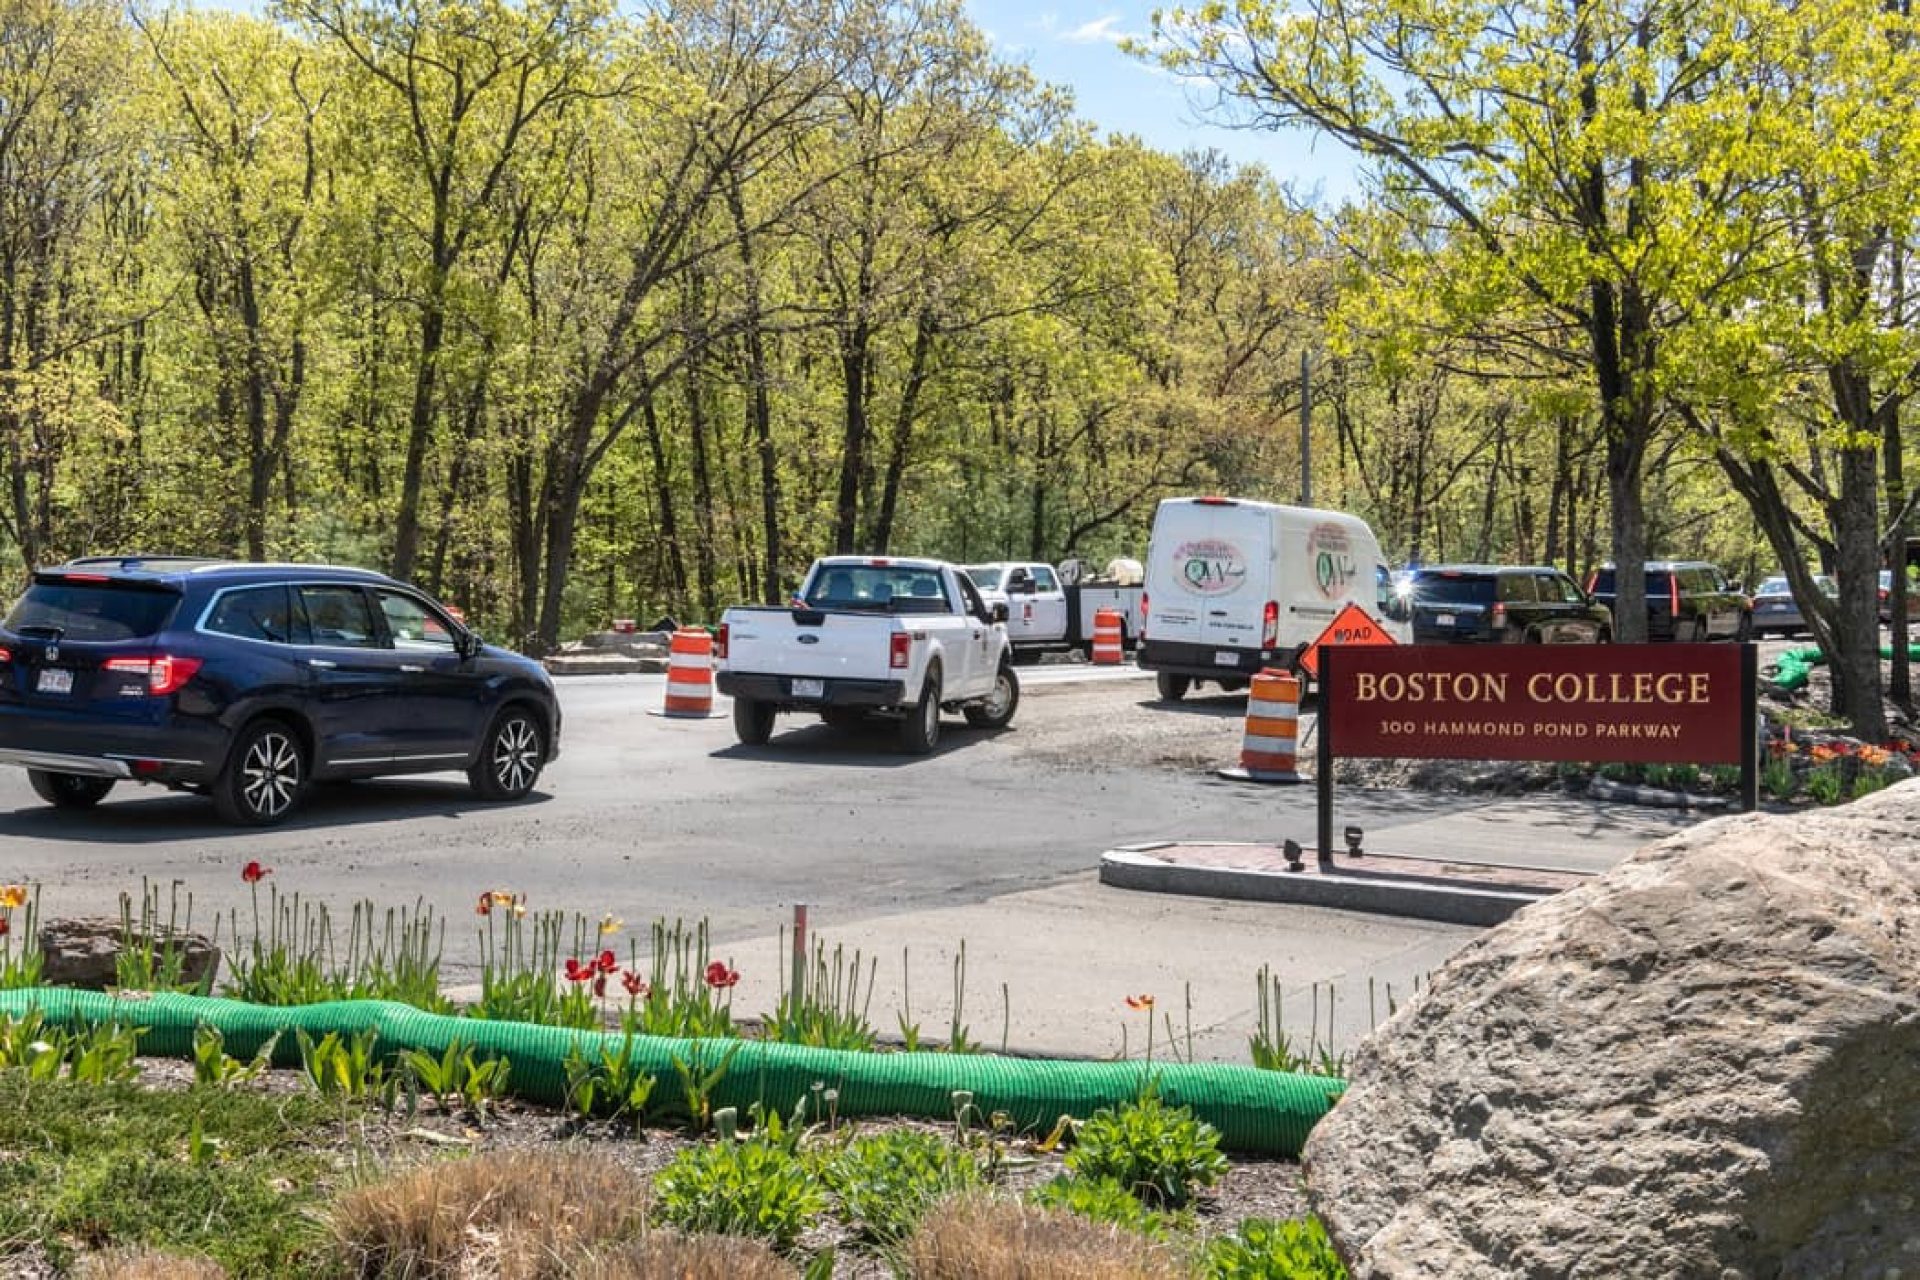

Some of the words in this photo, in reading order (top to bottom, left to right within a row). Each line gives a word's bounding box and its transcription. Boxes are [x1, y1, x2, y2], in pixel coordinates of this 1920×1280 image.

[1355, 671, 1508, 703] BOSTON
[1526, 671, 1710, 705] COLLEGE
[1380, 721, 1416, 735] 300
[1424, 721, 1526, 736] HAMMOND
[1533, 722, 1588, 737] POND
[1595, 722, 1682, 738] PARKWAY
